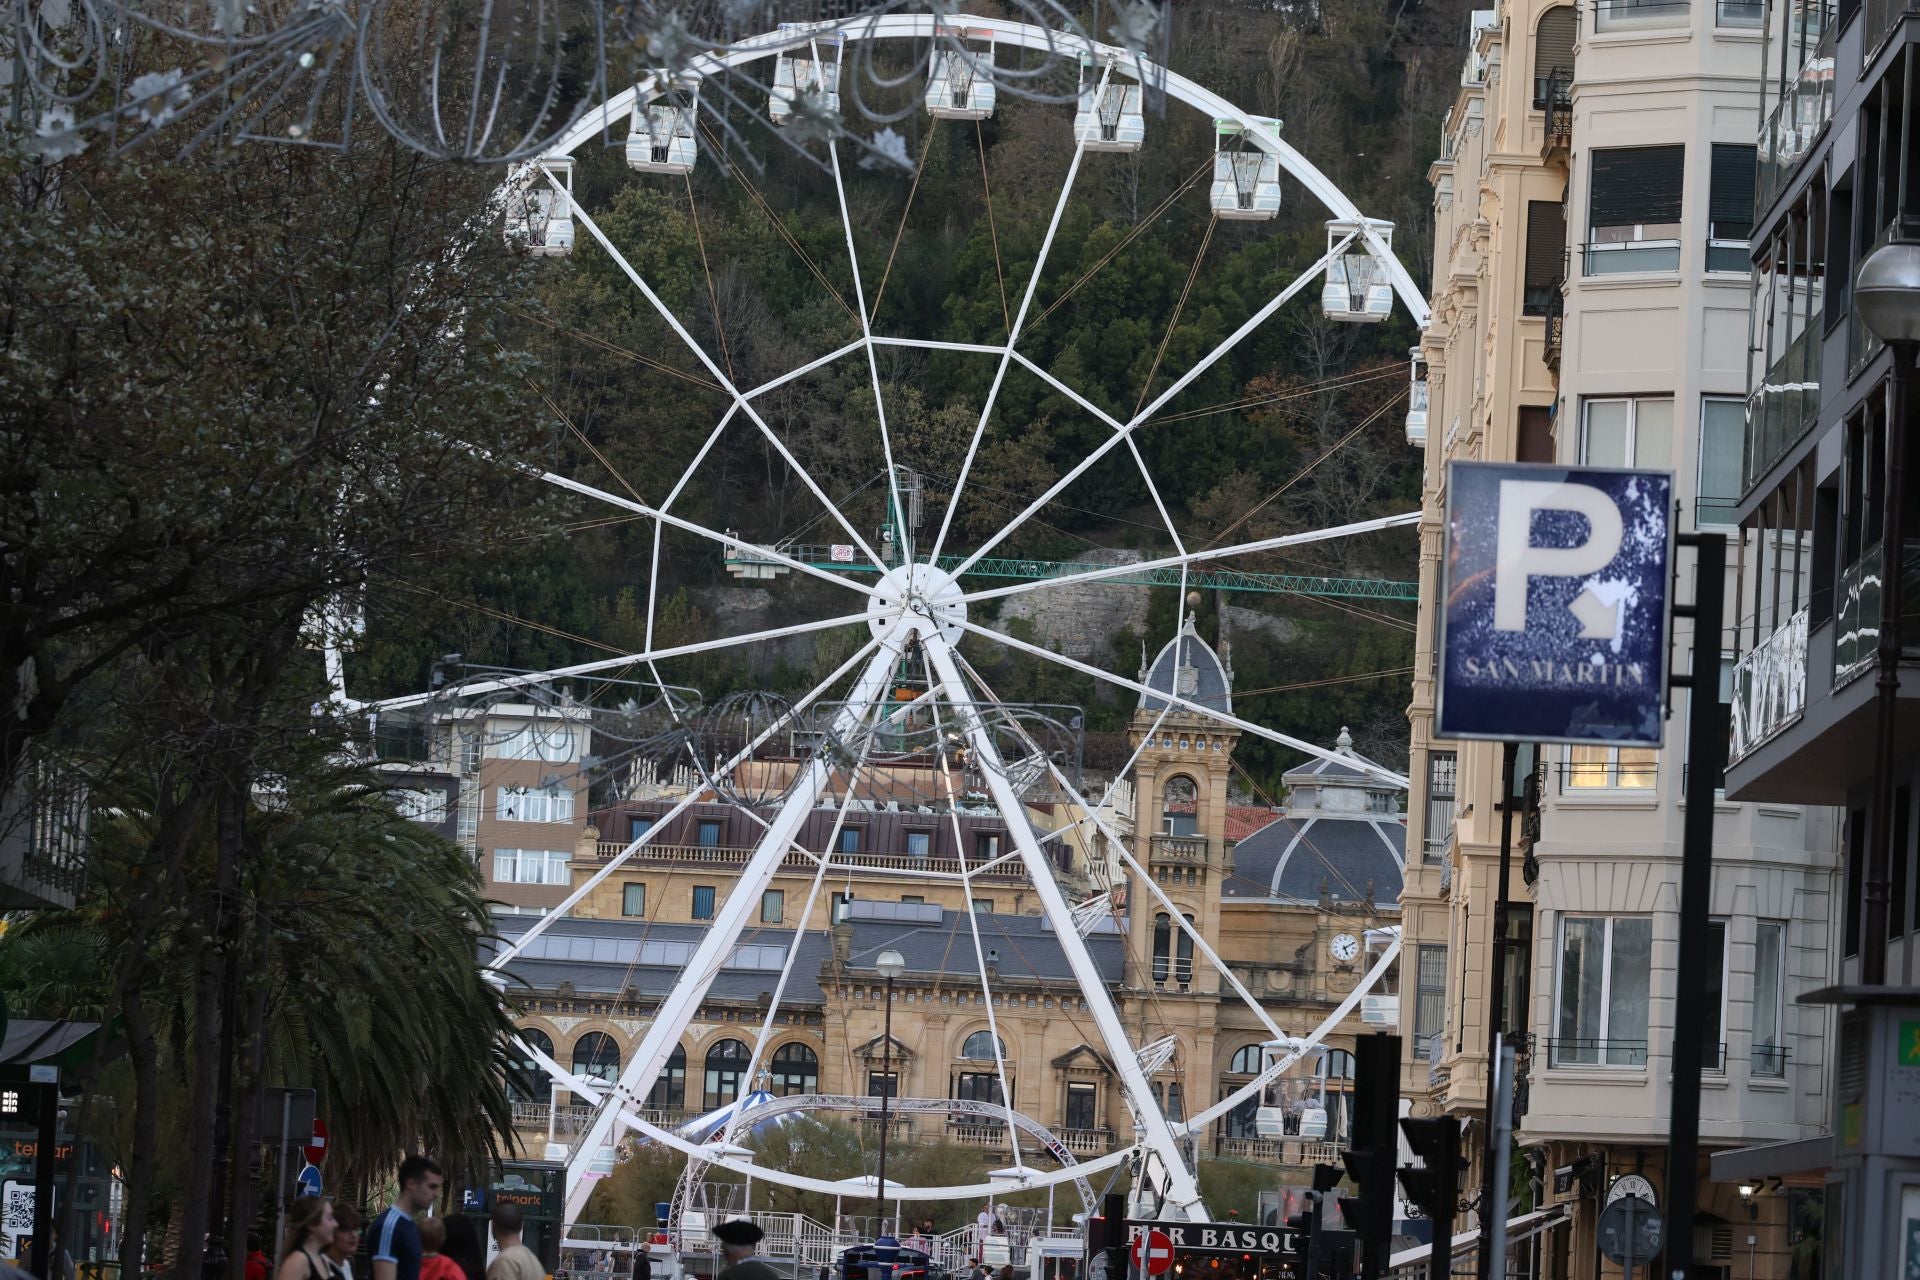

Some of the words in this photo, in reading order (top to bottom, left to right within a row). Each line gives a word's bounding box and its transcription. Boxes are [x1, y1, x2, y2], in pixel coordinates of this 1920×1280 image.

[1493, 479, 1624, 633] P
[1465, 656, 1520, 679] SAN
[1530, 660, 1644, 686] MARTIN
[15, 1141, 73, 1159] telar
[1128, 1225, 1185, 1245] BR
[1201, 1228, 1299, 1253] BASQU
